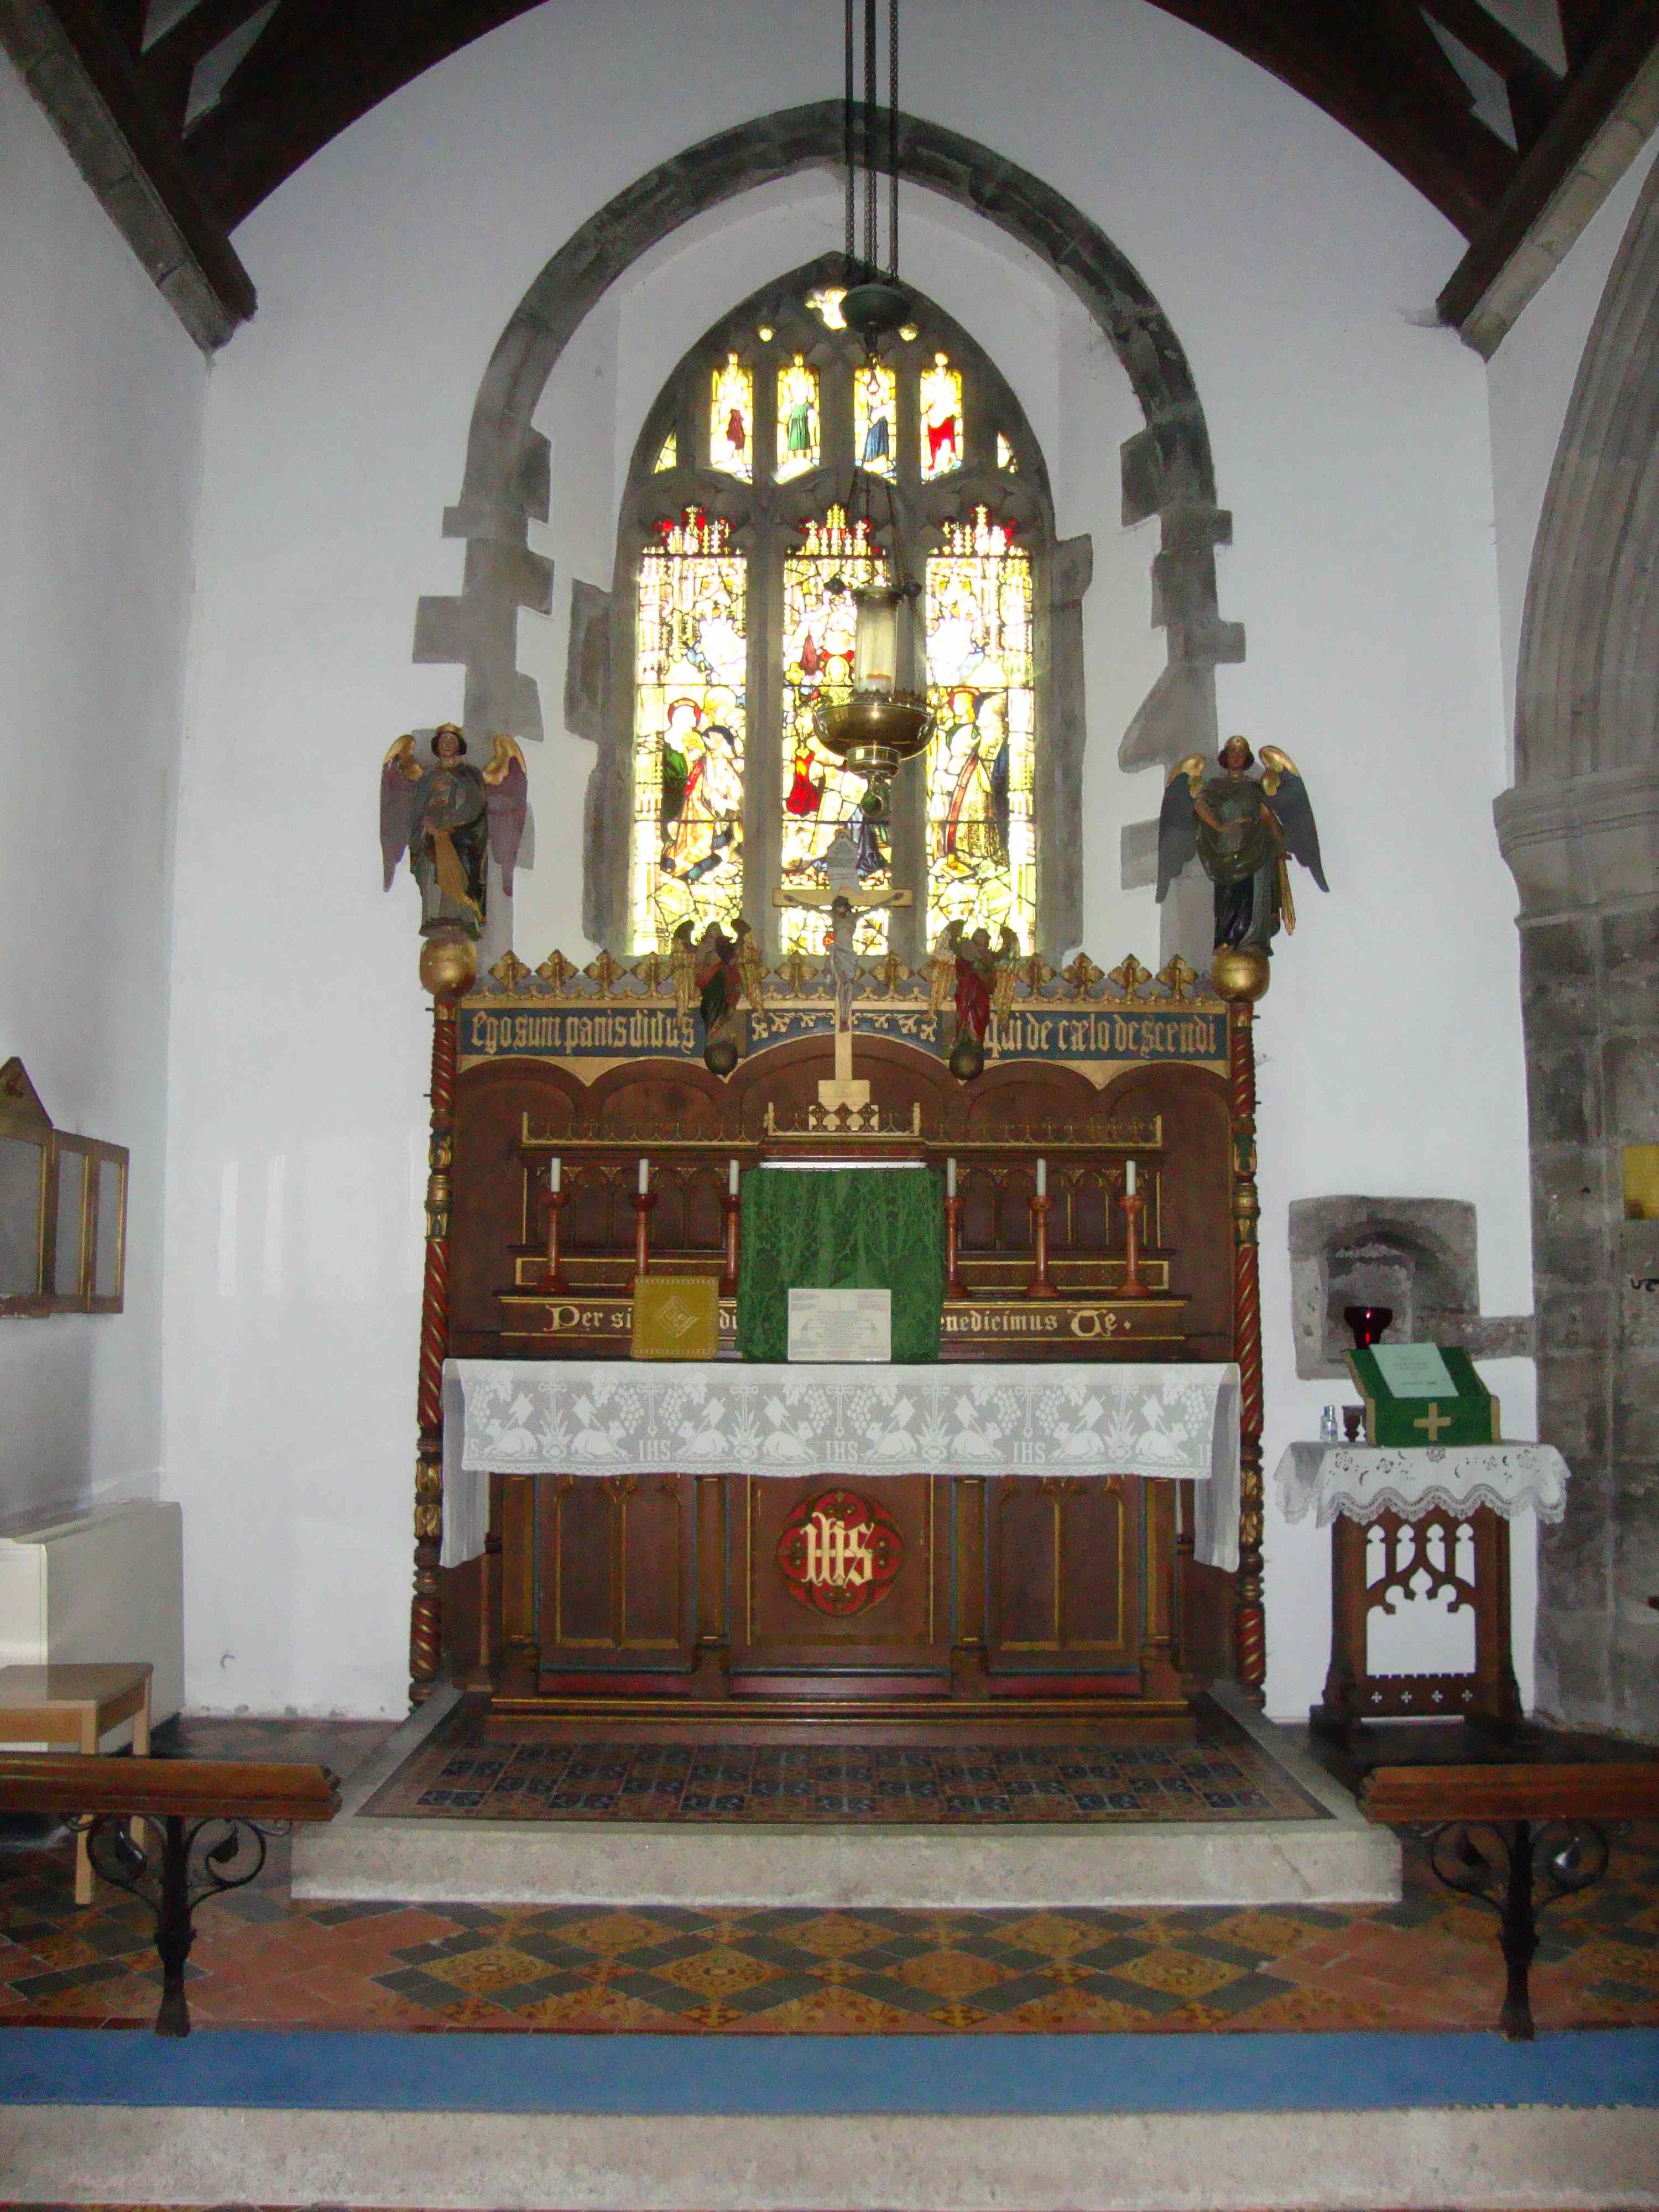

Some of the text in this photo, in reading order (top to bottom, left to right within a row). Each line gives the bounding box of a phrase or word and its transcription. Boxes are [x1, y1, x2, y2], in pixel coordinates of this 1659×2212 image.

[564, 1009, 627, 1055] panis
[1026, 1013, 1053, 1051] de
[1112, 1014, 1217, 1059] descendi
